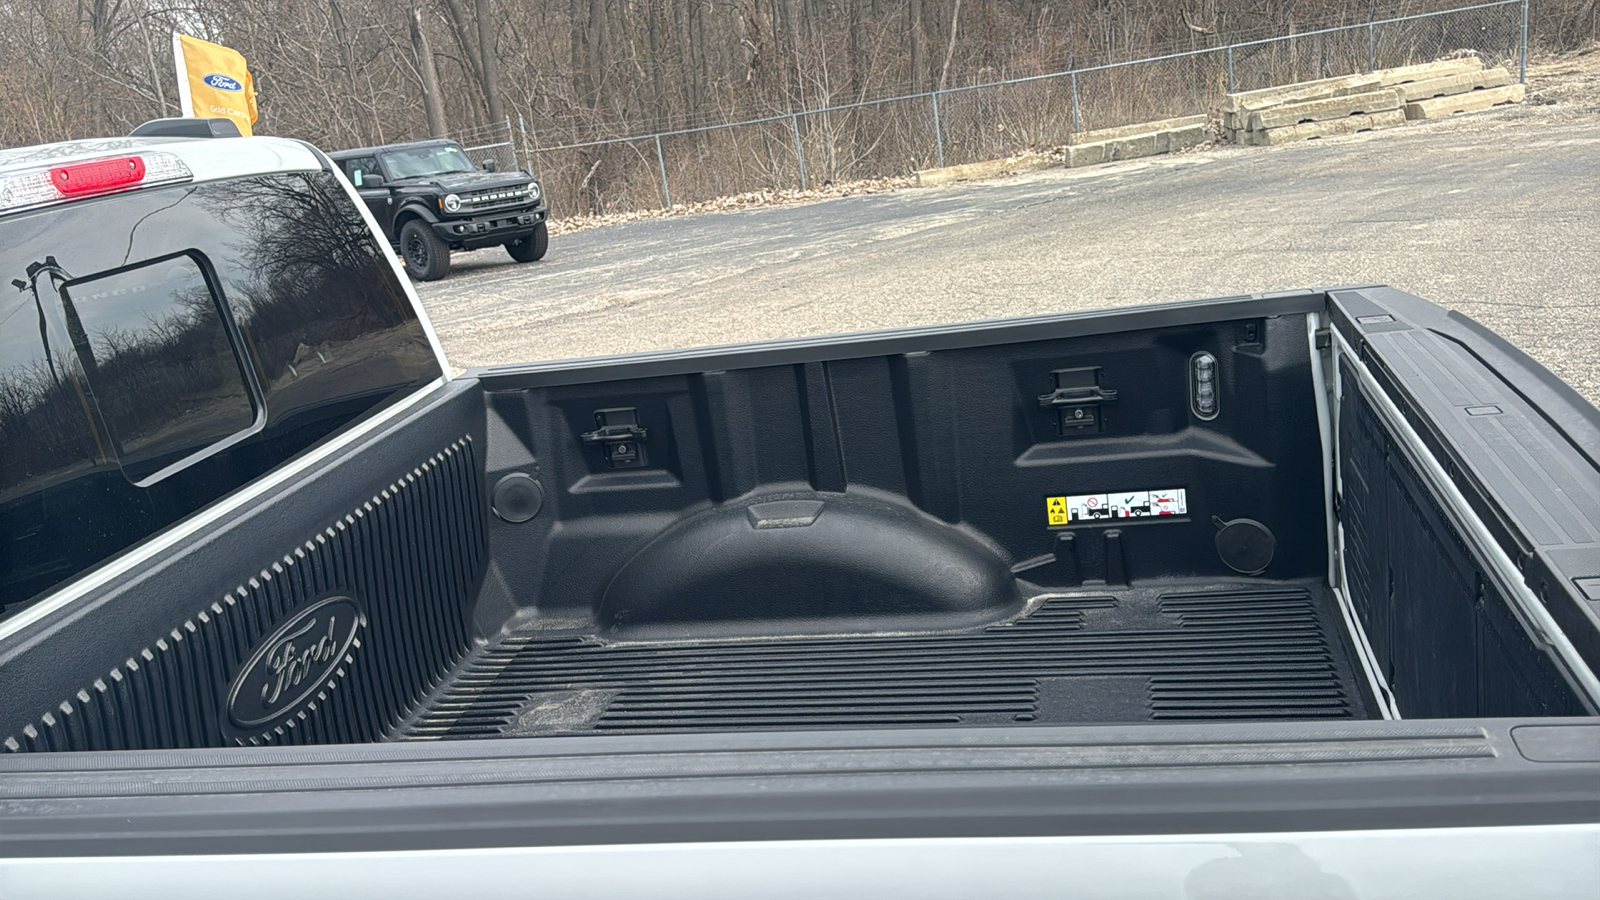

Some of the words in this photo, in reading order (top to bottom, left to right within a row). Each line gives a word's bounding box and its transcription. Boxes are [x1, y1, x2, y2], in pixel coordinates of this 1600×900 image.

[210, 75, 237, 89] Ford
[209, 104, 225, 115] Gold
[472, 190, 522, 201] BRONCO
[261, 616, 337, 706] Ford
